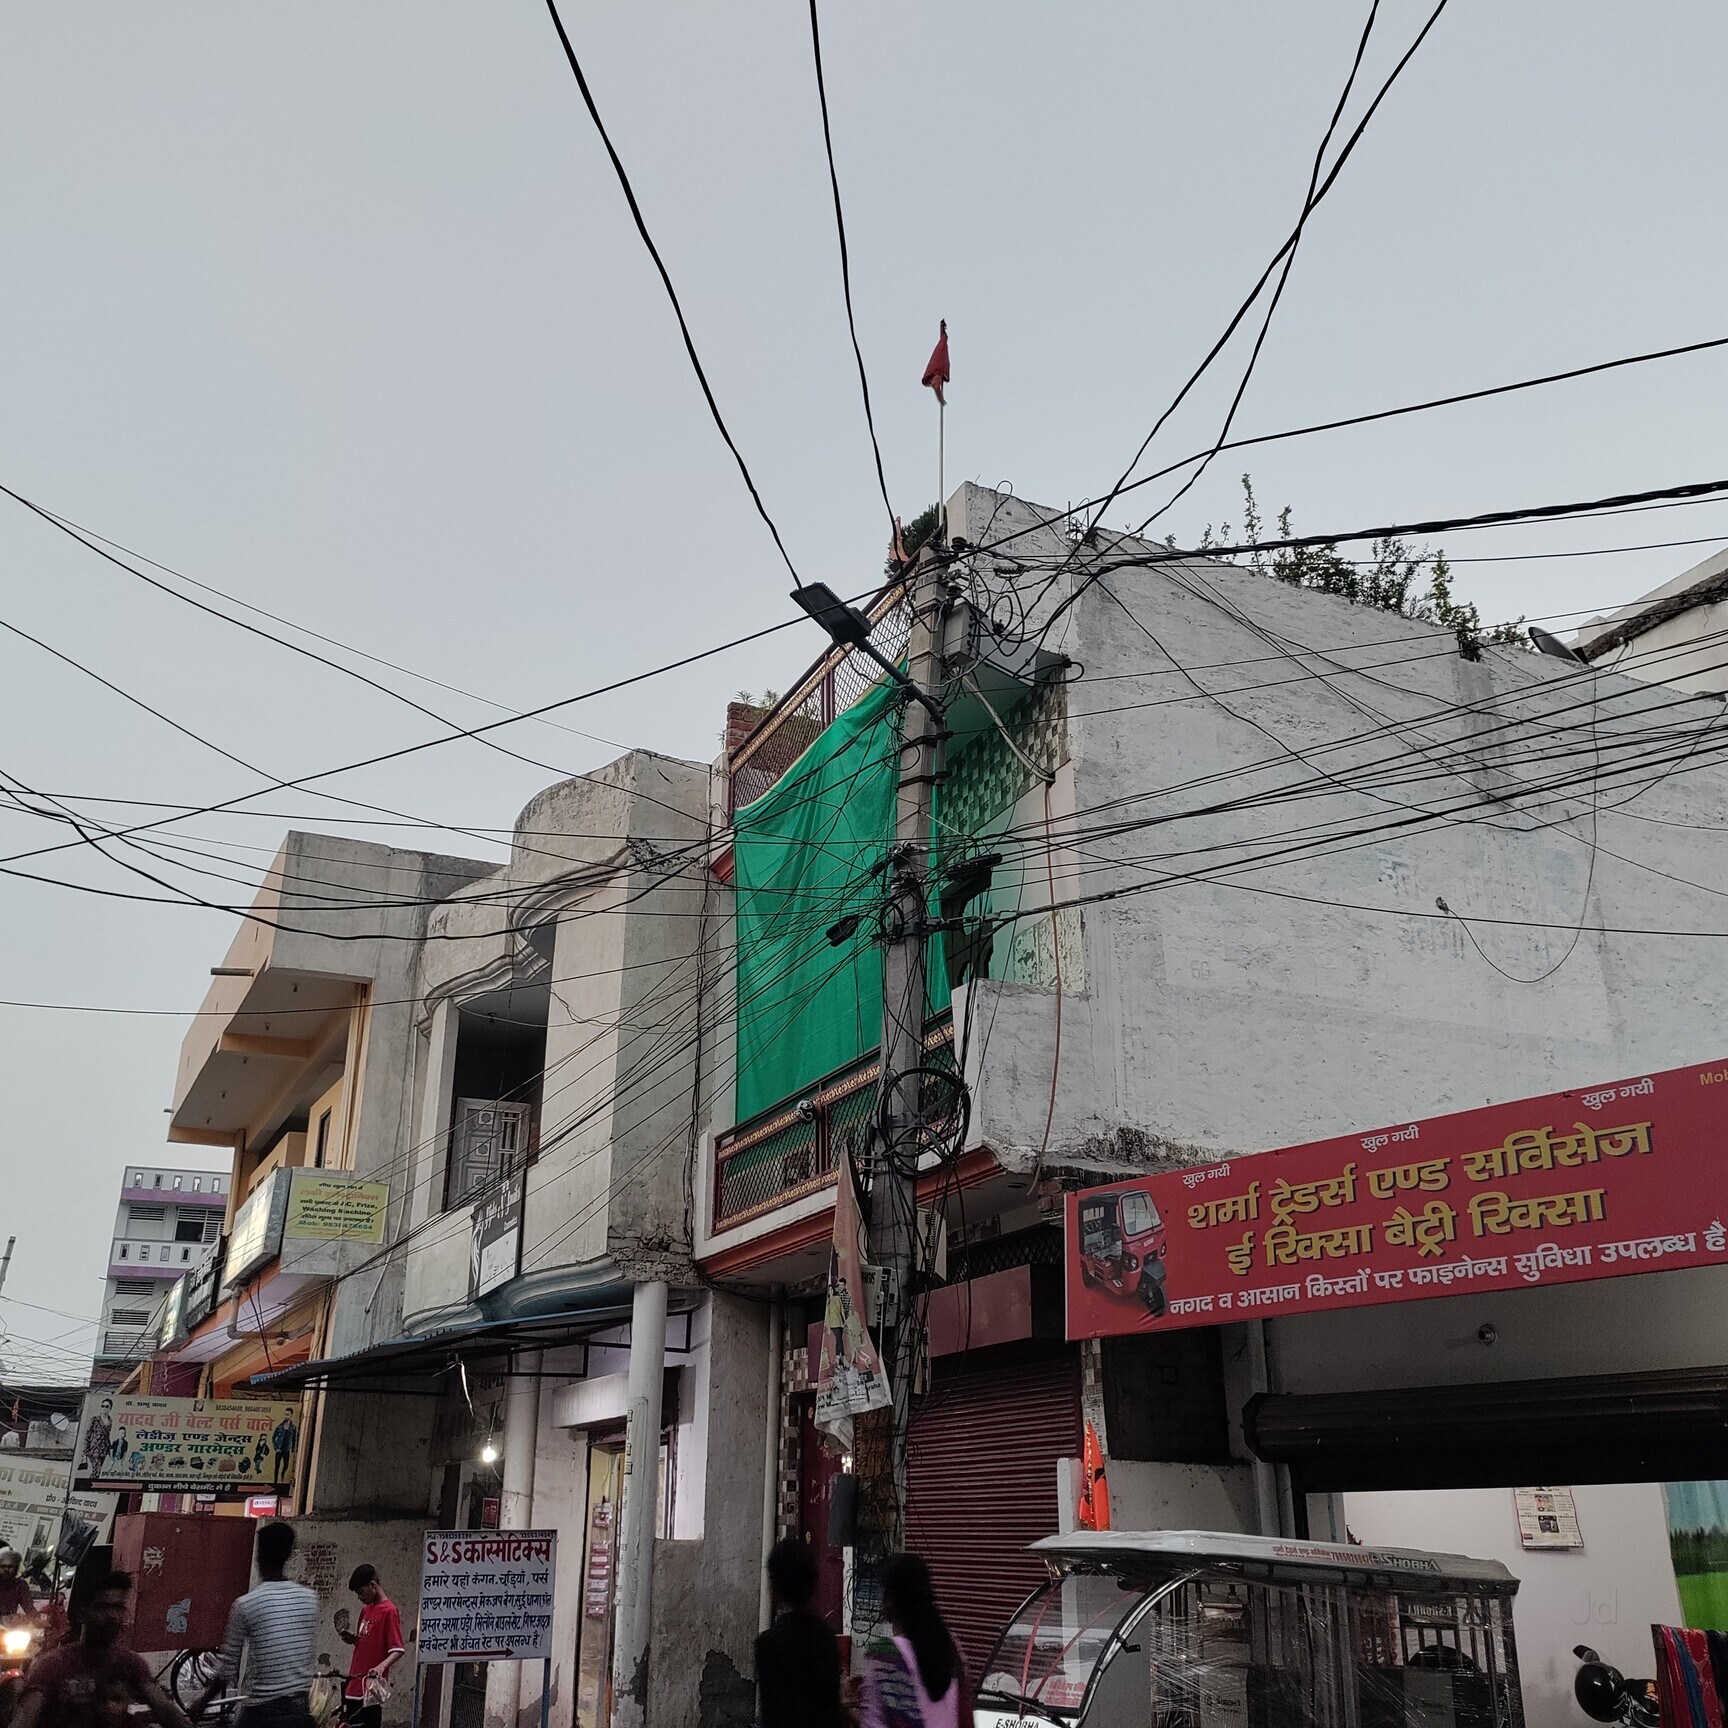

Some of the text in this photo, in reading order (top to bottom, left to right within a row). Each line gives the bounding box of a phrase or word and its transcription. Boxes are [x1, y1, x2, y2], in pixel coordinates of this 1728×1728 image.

[1581, 1077, 1655, 1110] खुल गयी
[1360, 1124, 1420, 1152] खुल गयी
[1182, 1163, 1231, 1188] खुल गयी
[1187, 1121, 1654, 1229] शर्मा ट्रेडर्स एण्ड सर्विसेज
[1225, 1188, 1608, 1276] ई रिक्सा बैट्री रिक्सा
[1170, 1219, 1728, 1315] नगद व आसान किस्तों पर फाइनेन्स सुविधा उपलब्ध है
[118, 1412, 155, 1426] यादव
[161, 1410, 181, 1427] जी
[219, 1414, 242, 1430] पर्स
[246, 1416, 275, 1431] वाले
[140, 1442, 182, 1452] अण्डर
[182, 1432, 210, 1442] एण्ड
[424, 1570, 450, 1591] हमारे
[532, 1568, 550, 1584] पर्स
[450, 1634, 460, 1650] भी
[459, 1634, 481, 1650] उचित
[481, 1633, 494, 1650] रेट
[494, 1636, 506, 1648] पर
